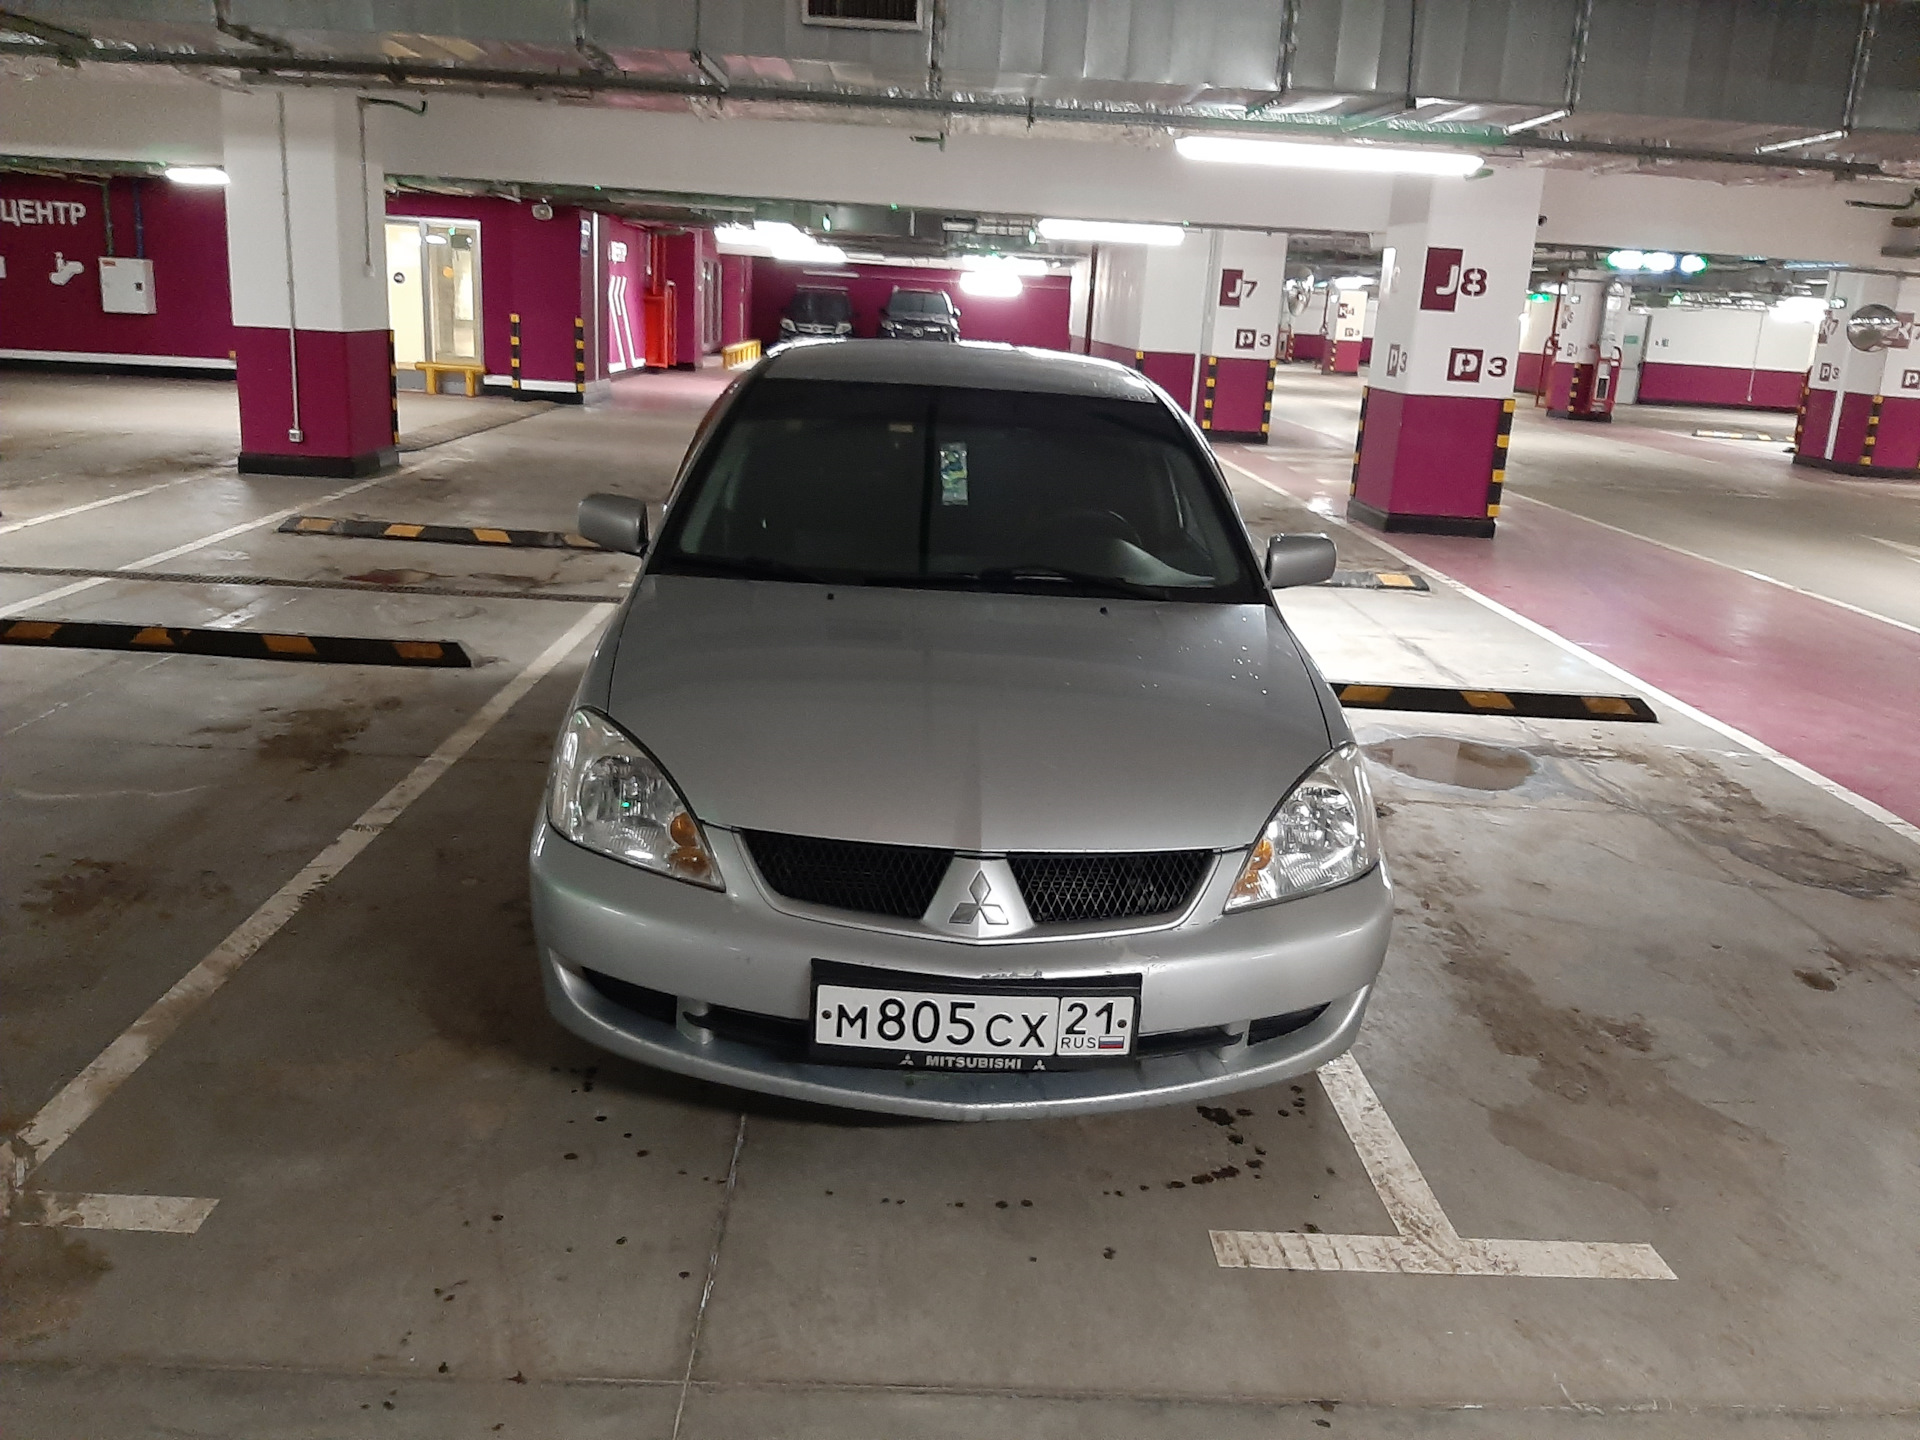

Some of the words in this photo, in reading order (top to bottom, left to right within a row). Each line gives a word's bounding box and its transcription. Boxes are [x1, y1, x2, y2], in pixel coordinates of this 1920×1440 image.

[1226, 278, 1258, 298] J7
[1435, 264, 1488, 297] J8
[1065, 1002, 1114, 1035] 21
[1061, 1037, 1096, 1049] RUS
[925, 1055, 1022, 1070] MITSUBISHI
